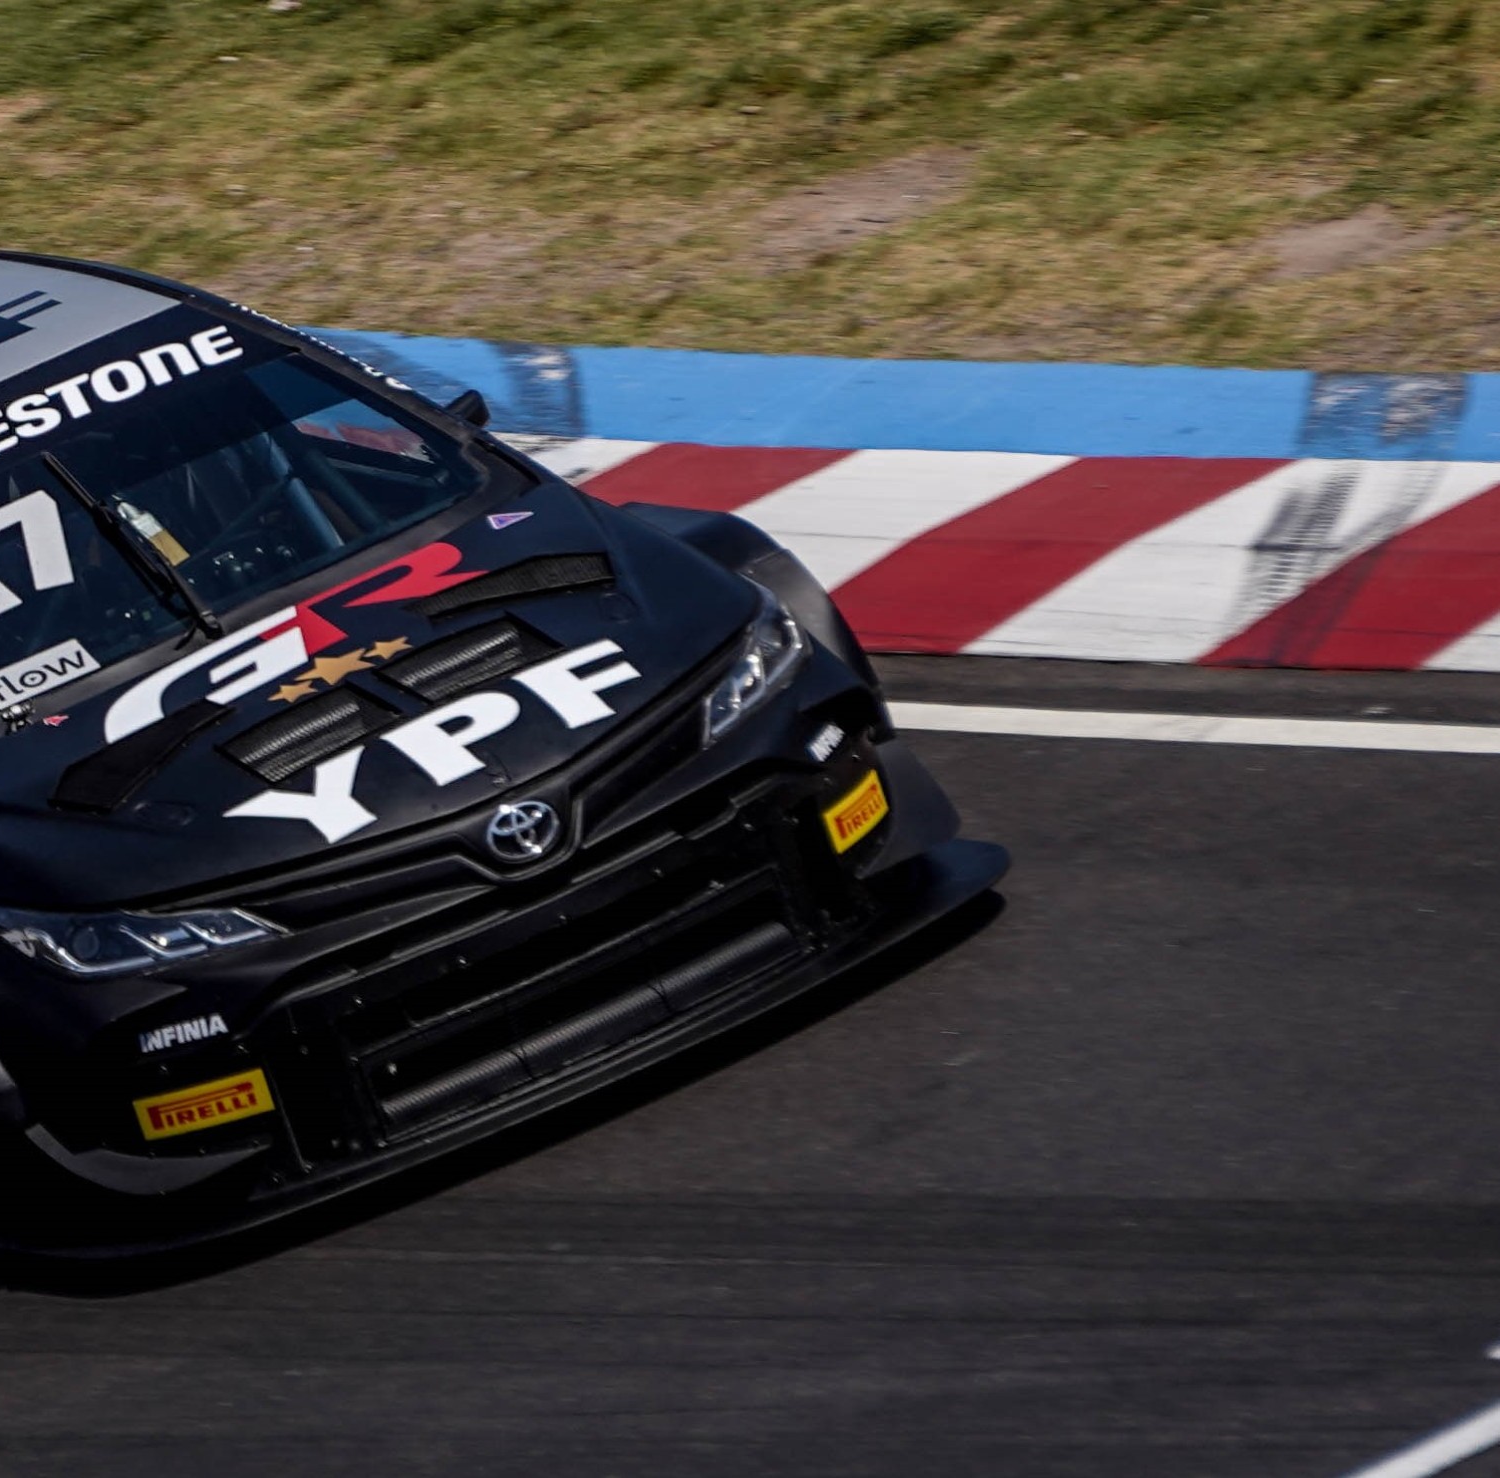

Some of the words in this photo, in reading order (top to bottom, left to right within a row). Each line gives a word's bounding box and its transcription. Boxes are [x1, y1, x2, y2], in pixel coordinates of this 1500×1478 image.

[104, 541, 490, 744] GR
[222, 638, 642, 844] YPF
[138, 1013, 229, 1053] INFINIA
[148, 1082, 257, 1131] PIRELLI
